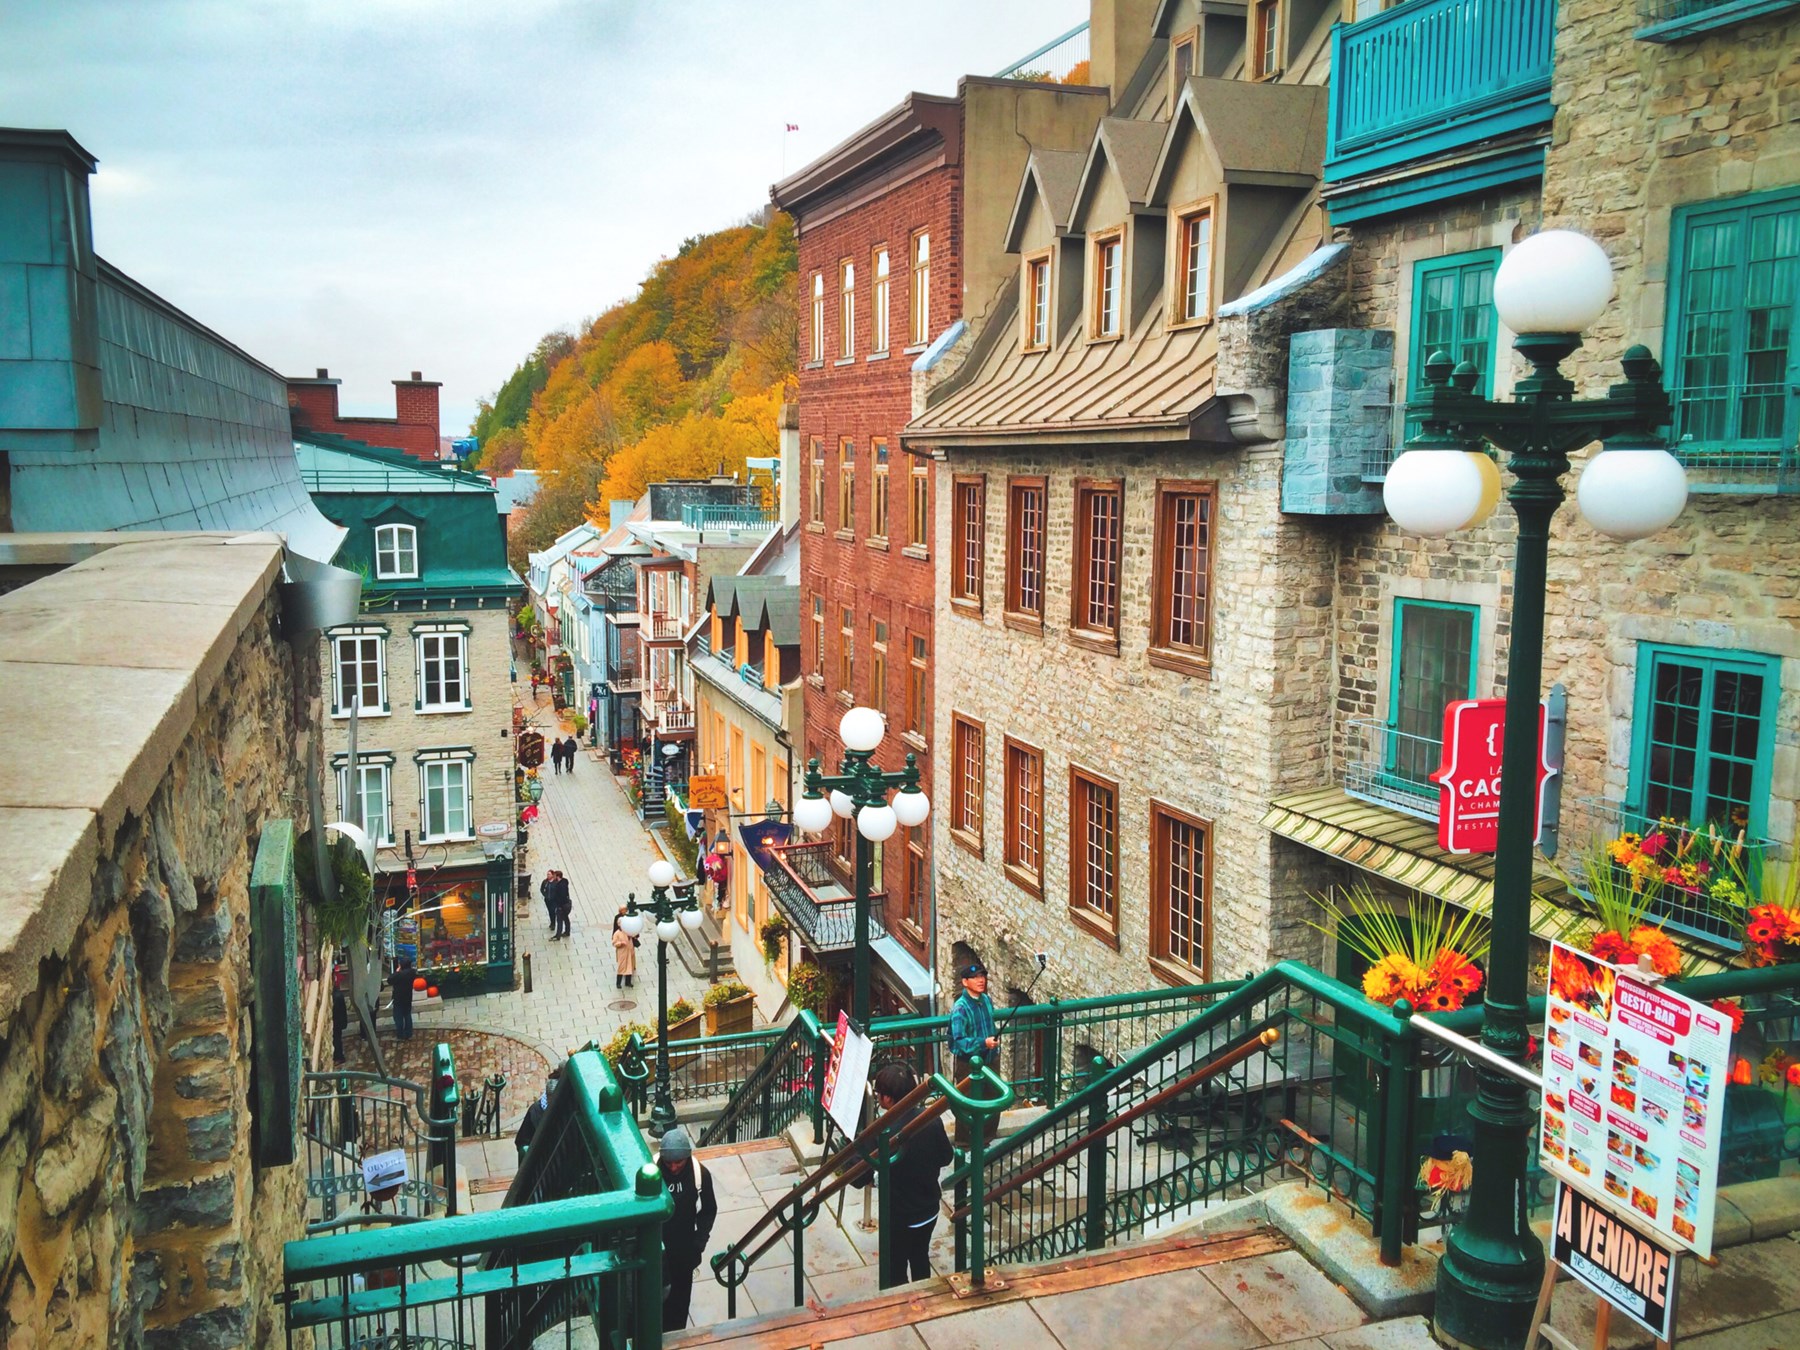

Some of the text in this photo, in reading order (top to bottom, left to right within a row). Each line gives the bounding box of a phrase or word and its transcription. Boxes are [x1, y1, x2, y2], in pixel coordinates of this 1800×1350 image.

[1489, 765, 1502, 776] LA
[1459, 777, 1502, 798] CAC
[1470, 800, 1500, 810] CHAM
[1457, 822, 1499, 831] RESTAU
[1620, 990, 1676, 1028] RESTO-BAR
[367, 1158, 401, 1173] OUVERT
[1579, 1200, 1669, 1308] VENDRE
